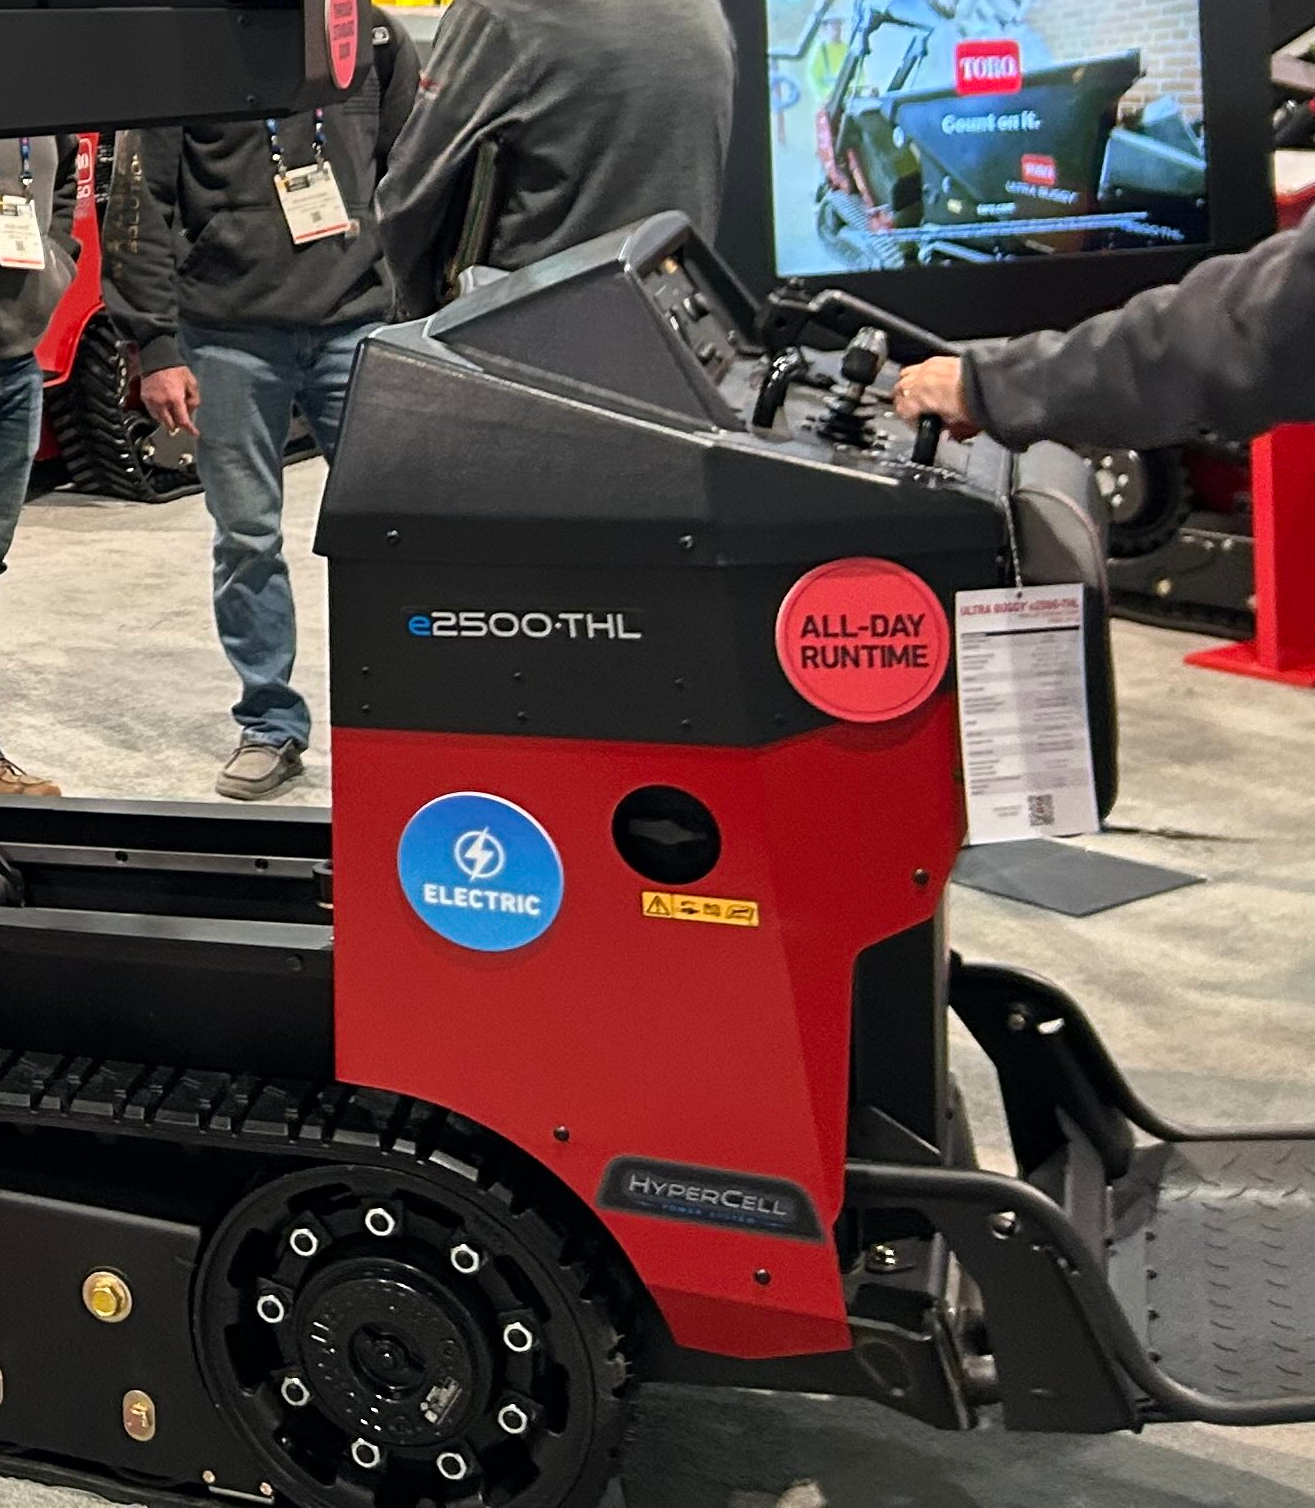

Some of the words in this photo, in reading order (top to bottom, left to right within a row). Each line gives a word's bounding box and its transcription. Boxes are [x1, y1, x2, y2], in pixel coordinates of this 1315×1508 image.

[959, 54, 1017, 81] TORO
[800, 613, 926, 639] ALL-DAY
[800, 643, 930, 669] RUNTIME
[423, 883, 541, 916] ELECTRIC
